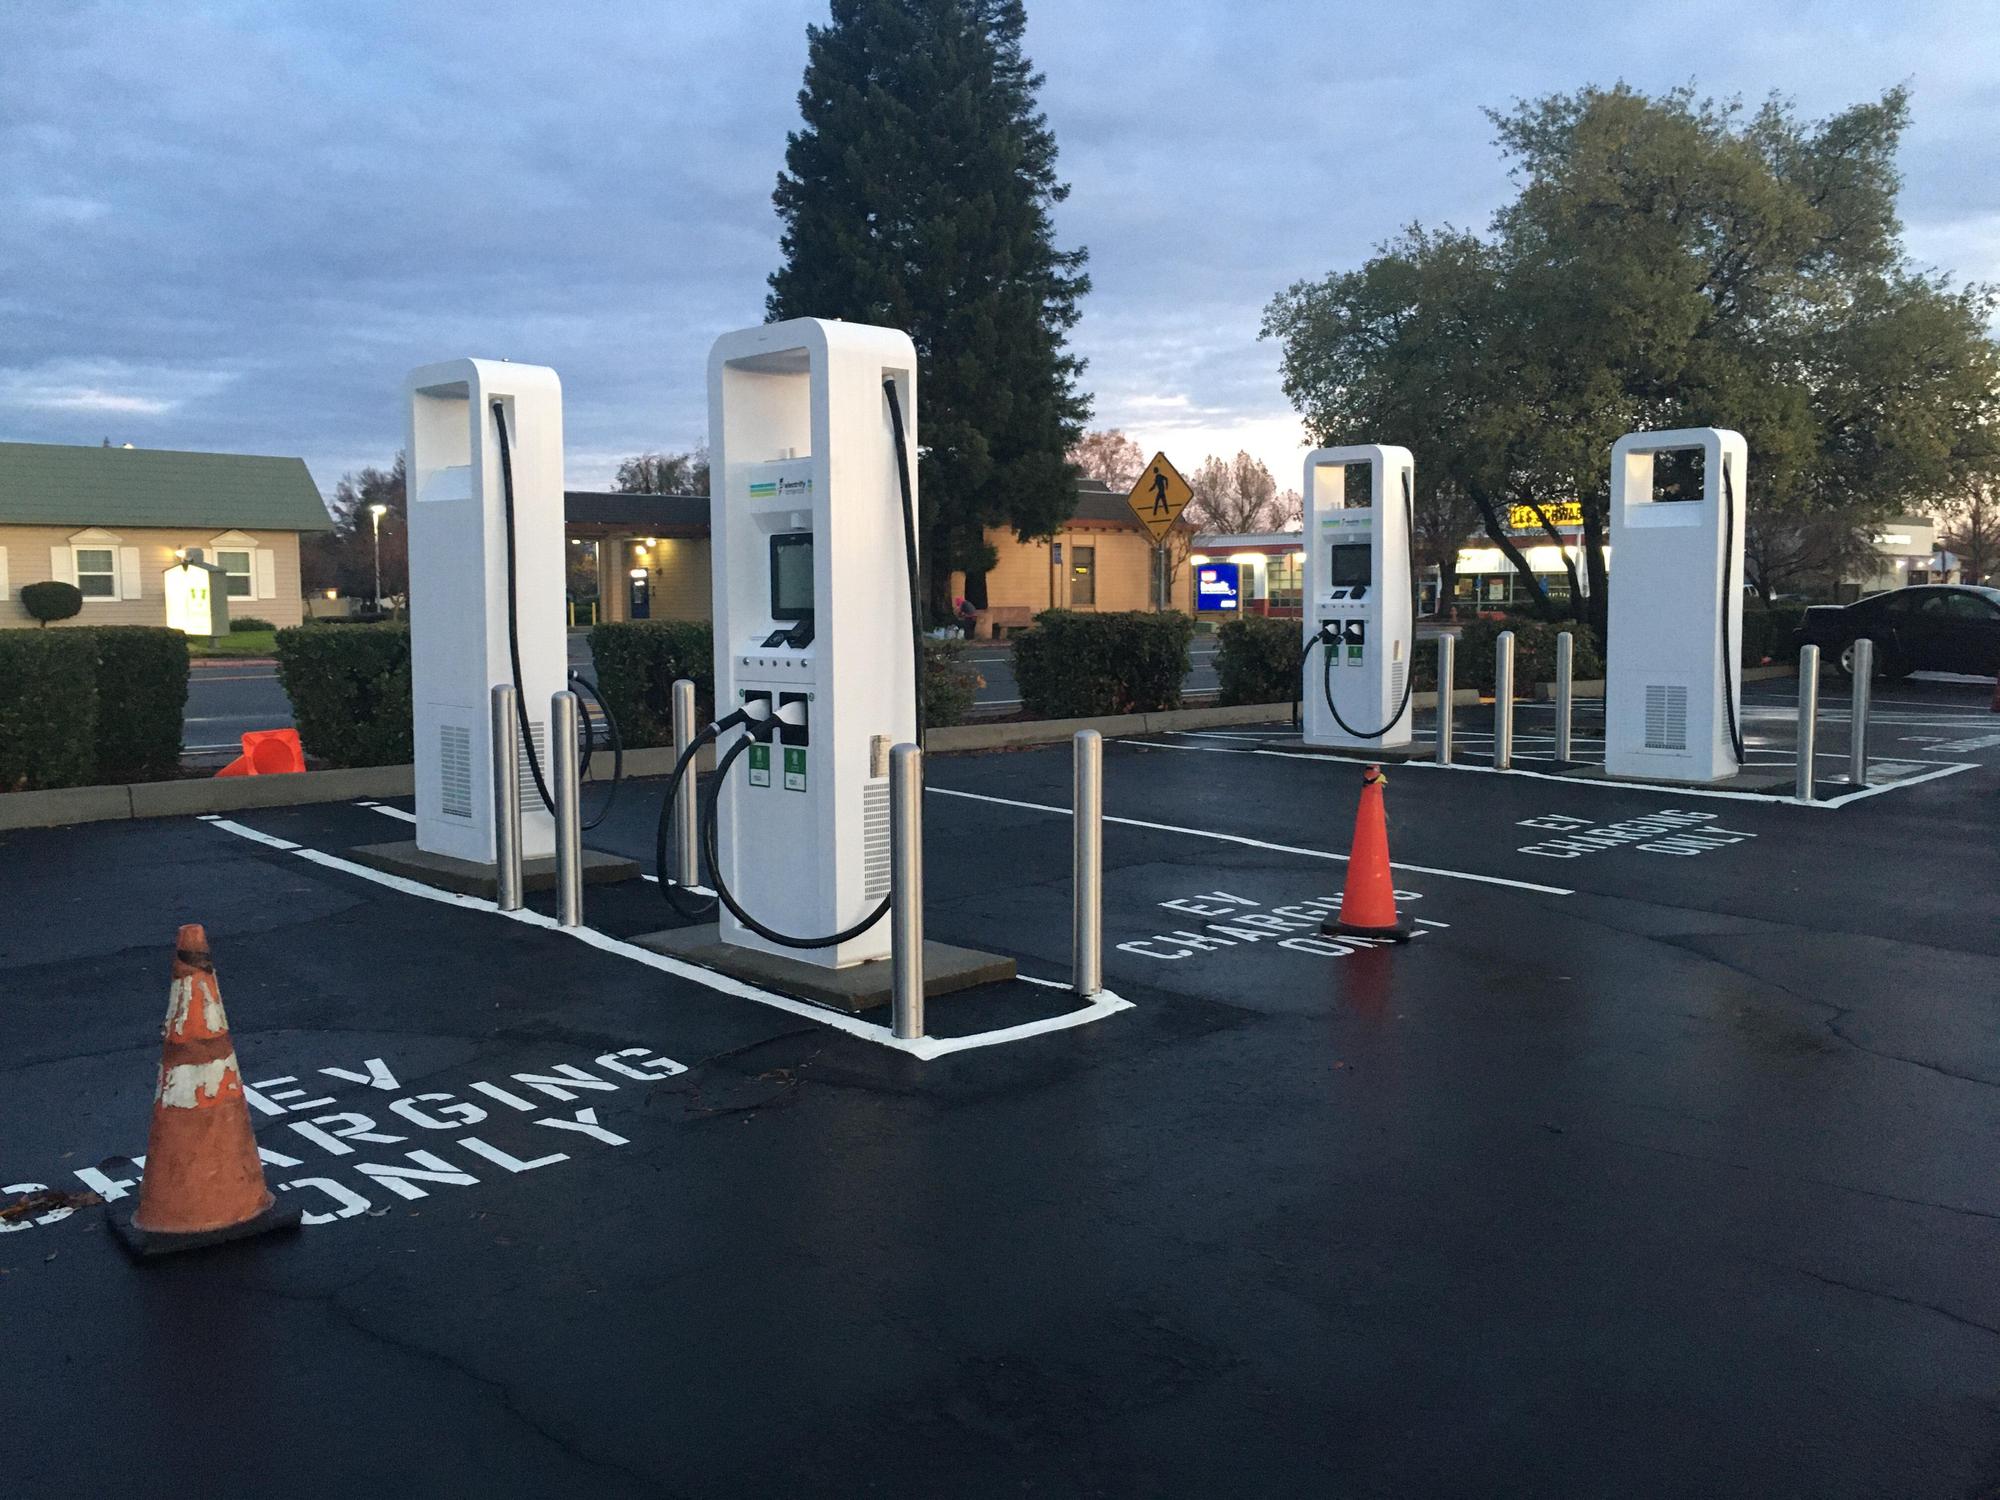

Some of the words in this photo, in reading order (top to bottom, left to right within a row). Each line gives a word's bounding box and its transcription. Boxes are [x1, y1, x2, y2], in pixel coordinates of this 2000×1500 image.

[1533, 506, 1584, 522] CHWAB
[1515, 814, 1595, 831] EV
[1517, 808, 1719, 858] CHARGING
[1636, 825, 1758, 856] ONLY
[1157, 890, 1261, 916] EV
[242, 1057, 400, 1116] EV
[278, 1107, 631, 1225] ONLY
